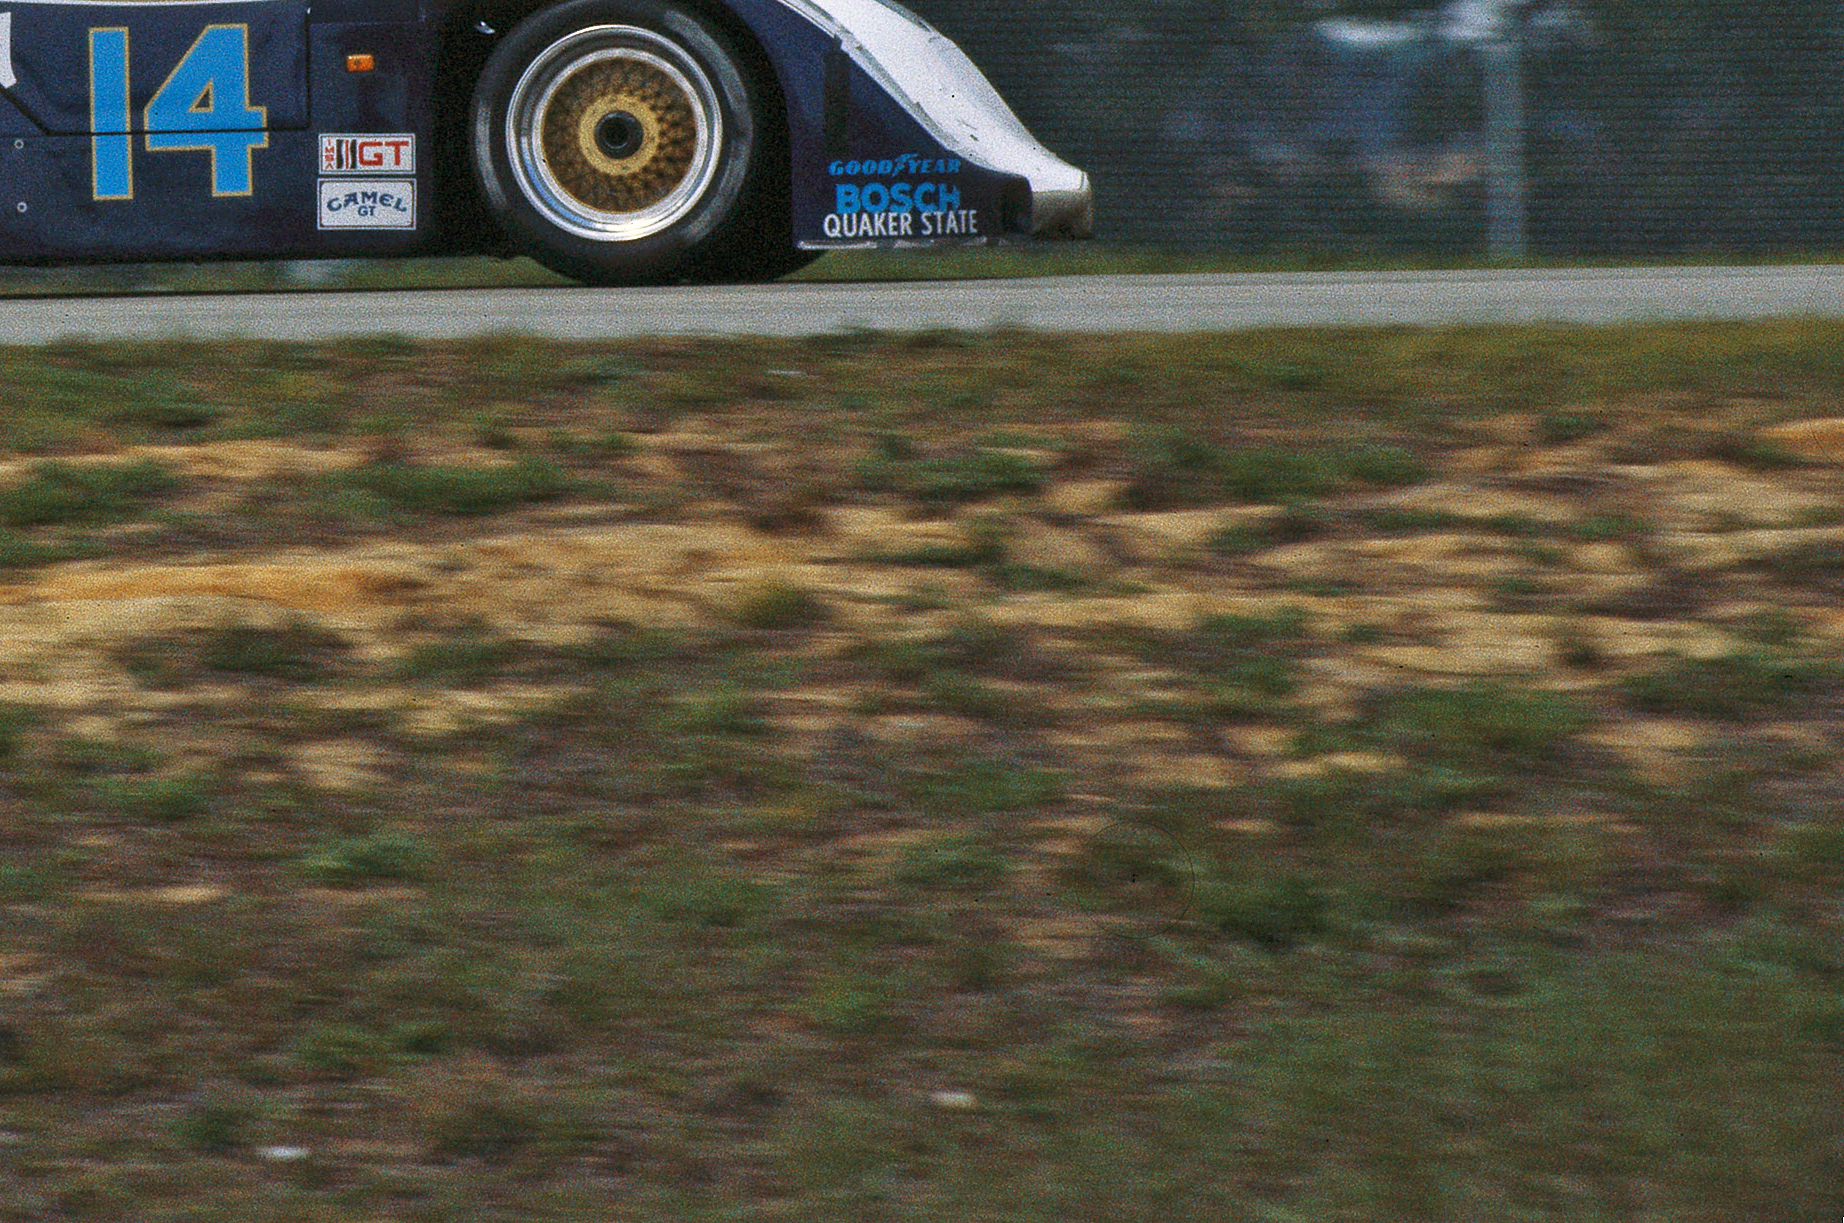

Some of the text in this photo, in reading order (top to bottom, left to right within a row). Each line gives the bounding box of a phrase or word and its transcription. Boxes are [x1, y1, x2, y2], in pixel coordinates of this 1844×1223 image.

[89, 23, 269, 200] 14
[358, 141, 409, 166] GT
[326, 191, 408, 212] CAMEL
[358, 205, 376, 216] GT
[835, 182, 960, 214] BOSCH
[823, 210, 977, 237] QUAKER STATE
